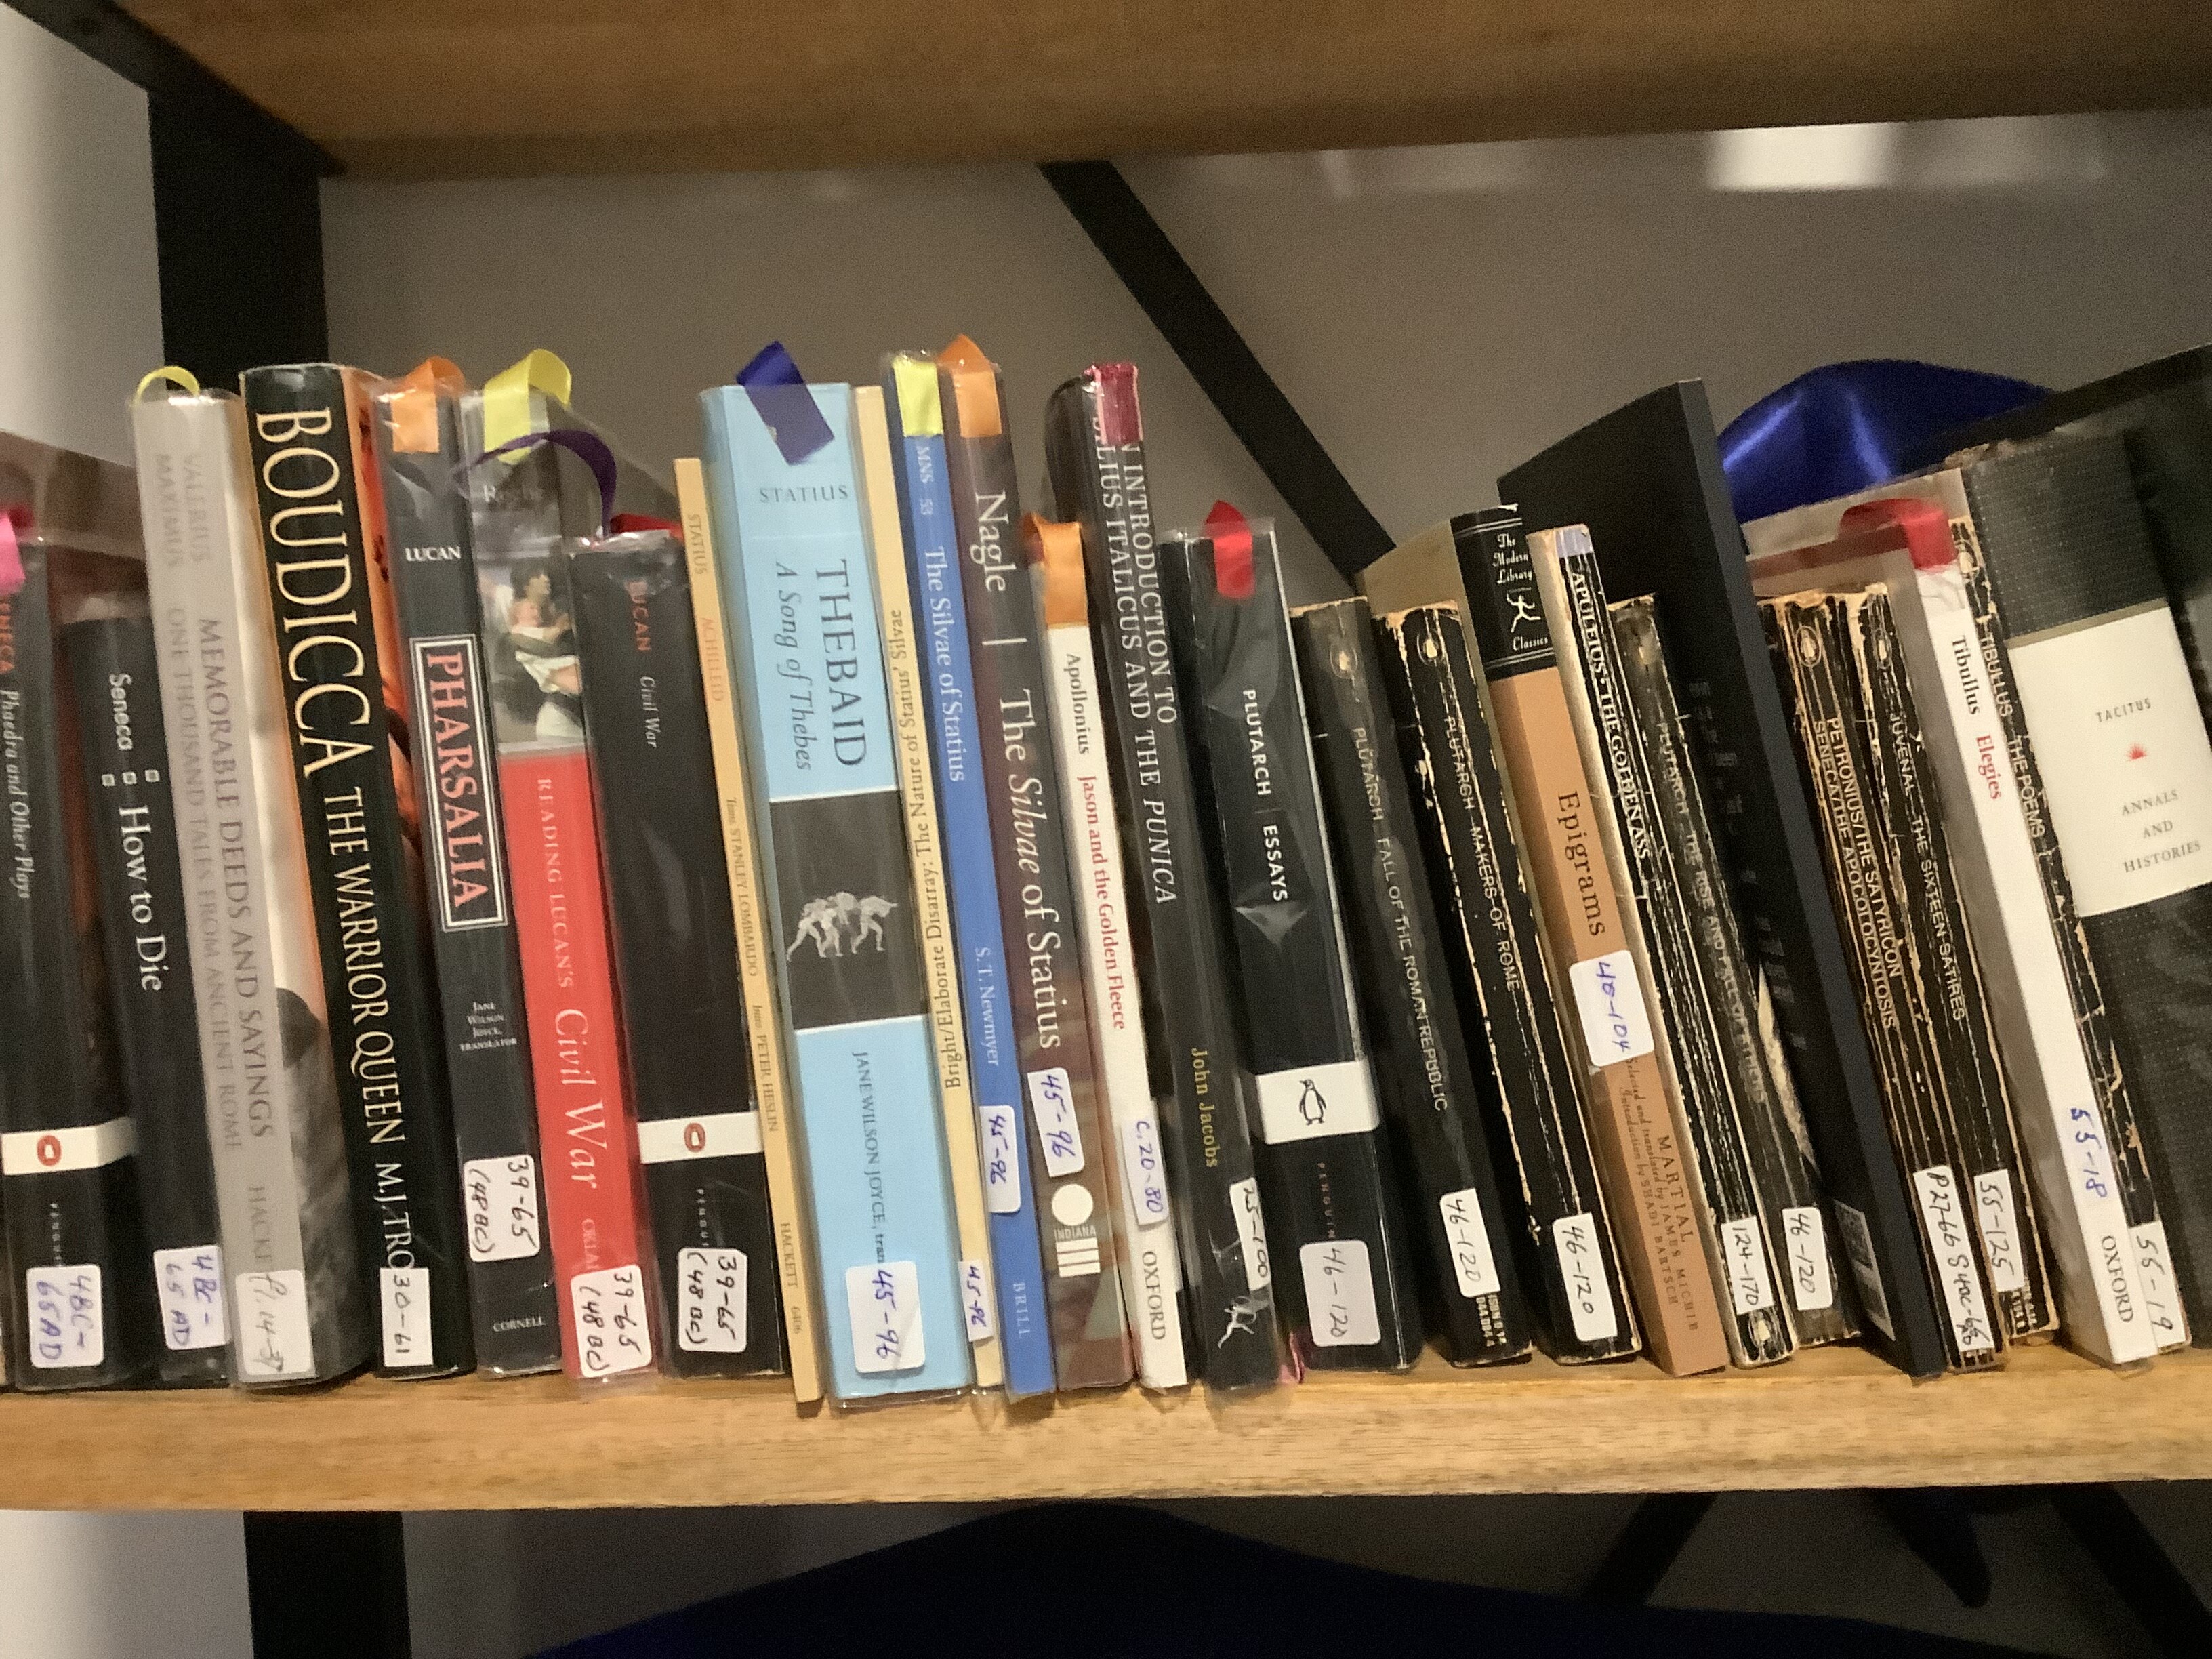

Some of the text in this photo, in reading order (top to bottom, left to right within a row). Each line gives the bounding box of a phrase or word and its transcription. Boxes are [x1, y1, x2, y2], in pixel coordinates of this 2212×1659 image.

[759, 484, 848, 504] STATIUS
[916, 444, 934, 484] MNS
[405, 545, 462, 562] LUCAN
[687, 512, 708, 575] STATIUS
[963, 487, 1019, 594] Nagle
[1492, 550, 1530, 567] Modern
[1496, 533, 1516, 548] The
[1496, 569, 1533, 585] Library
[1105, 517, 1143, 652] ITALICUS
[1123, 462, 1171, 678] INTRODUCTION
[1153, 686, 1179, 726] TO
[769, 558, 820, 772] A Song of Thebes
[811, 558, 870, 767] THEBAID
[883, 608, 909, 661] Silvae
[924, 544, 970, 782] The Silvae of Statius
[1513, 635, 1549, 651] Classics
[1951, 634, 1984, 716] Tibullus
[0, 689, 22, 758] Phaedra
[108, 672, 140, 751] Seneca
[639, 674, 662, 750] Civil War
[1061, 651, 1094, 756] Apollonius
[1124, 659, 1151, 722] AND
[1569, 570, 1652, 860] APULEIUS THE GOLDEN ASS
[2095, 698, 2152, 723] TACITUS
[255, 403, 407, 1147] BOUDICCA THE WARRIOR QUEEN
[899, 731, 919, 754] of
[1133, 729, 1162, 787] THE
[1242, 688, 1271, 796] PLUTARCH
[1971, 733, 2005, 802] Elegies
[1978, 631, 2047, 838] TIBULLUS THE POEMS
[6, 763, 27, 796] and
[419, 647, 496, 907] PHARSALIA
[901, 756, 930, 819] Nature
[2121, 789, 2179, 815] ANNALS
[9, 800, 32, 851] Other
[729, 826, 748, 890] STANLEY
[911, 821, 933, 858] The
[1142, 795, 1178, 904] PUNICA
[1262, 823, 1288, 902] ESSAYS
[1442, 716, 1521, 993] PLUTARCH MAKERS OF ROME
[1557, 790, 1613, 939] Epigrams
[1826, 715, 1902, 978] PETRONIUS/THE SATYRICON
[1885, 712, 1966, 1021] JUVENAL THE SIXTEEN SATIRES
[2123, 840, 2202, 874] HISTORIES
[2143, 819, 2174, 838] AND
[119, 804, 171, 992] How to Die
[197, 616, 275, 1139] MEMORABLE DEEDS AND SAYINGS
[537, 777, 575, 989] READING LUCAN'S
[918, 859, 944, 940] Disarray:
[998, 687, 1072, 1050] The Silvae of Statius
[1076, 774, 1129, 1030] Jason and the Golden Fleece
[1812, 718, 1896, 1029] SENECA/THE APOCOLOCYNTOSIS
[197, 888, 222, 958] FROM
[738, 893, 760, 977] LOMBARDO
[1352, 725, 1450, 1113] PLUTARCH FALL OF THE ROMAN REPUBLIC
[1706, 914, 1727, 951] AND
[204, 965, 233, 1073] ANCIENT
[756, 1033, 772, 1076] PETER
[929, 944, 964, 1090] Bright/Elaborate
[979, 985, 1002, 1068] Newmyer
[552, 1006, 613, 1193] Civil War
[852, 1050, 872, 1097] JANE
[1190, 1045, 1223, 1168] John Jacobs
[860, 1096, 879, 1164] WILSON
[501, 1156, 540, 1250] 39-65
[1635, 1103, 1652, 1126] and
[1659, 1203, 1681, 1258] JAMES
[1656, 1134, 1695, 1244] MARTIAL
[777, 1221, 800, 1290] HACKETT
[1054, 1225, 1097, 1241] INDIANA
[1444, 1197, 1483, 1285] 46-120
[1560, 1223, 1603, 1316] 46-120
[1974, 1176, 2019, 1280] 55-125
[386, 1272, 417, 1355] 30-61
[604, 1269, 650, 1359] 39-65
[712, 1254, 743, 1341] 39-65
[1012, 1281, 1031, 1338] BRILL
[1141, 1249, 1167, 1341] OXFORD
[1321, 1246, 1353, 1338] 46-120
[2100, 1233, 2135, 1324] OXFORD
[493, 1315, 546, 1332] CORNELL
